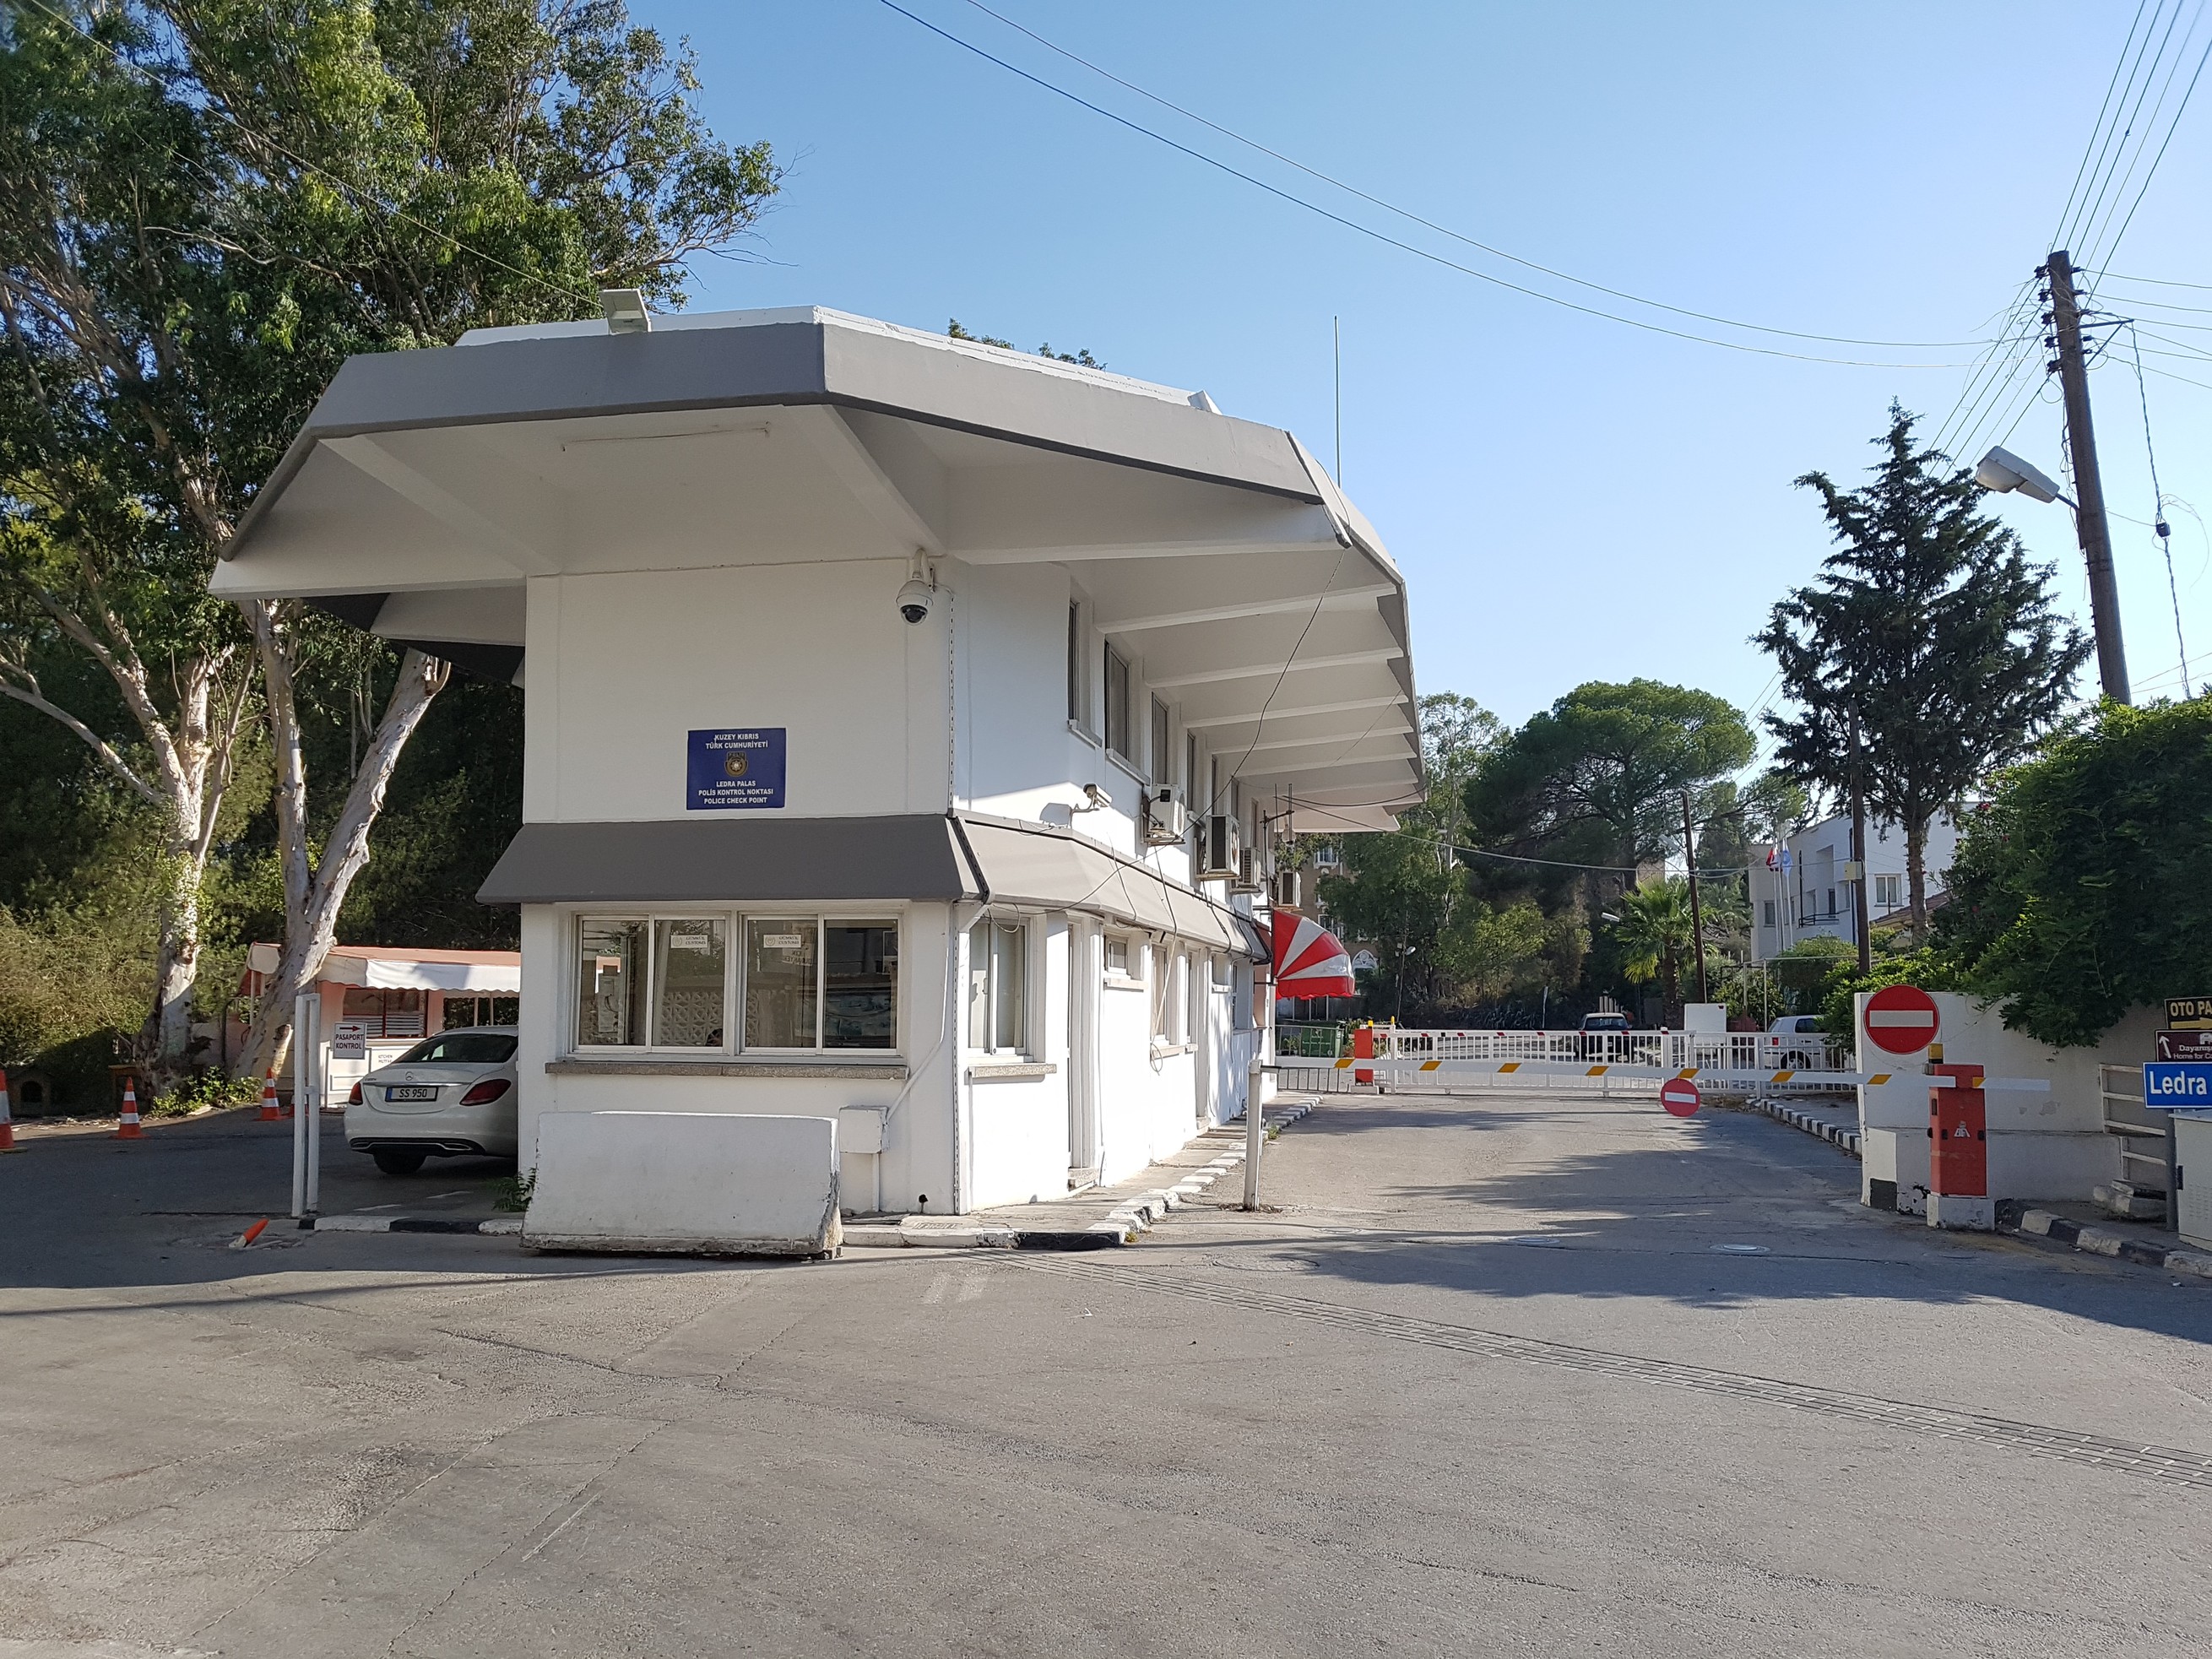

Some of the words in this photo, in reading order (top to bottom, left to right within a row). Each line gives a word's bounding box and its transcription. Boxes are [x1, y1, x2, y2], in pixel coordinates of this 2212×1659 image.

[706, 741, 723, 750] TÜRK
[724, 740, 768, 749] CUMHURİYETİ
[2170, 1001, 2194, 1017] OTO
[2179, 1044, 2212, 1053] Dayanış
[2150, 1071, 2207, 1095] Ledra
[398, 1089, 410, 1098] SS
[412, 1089, 427, 1098] 950
